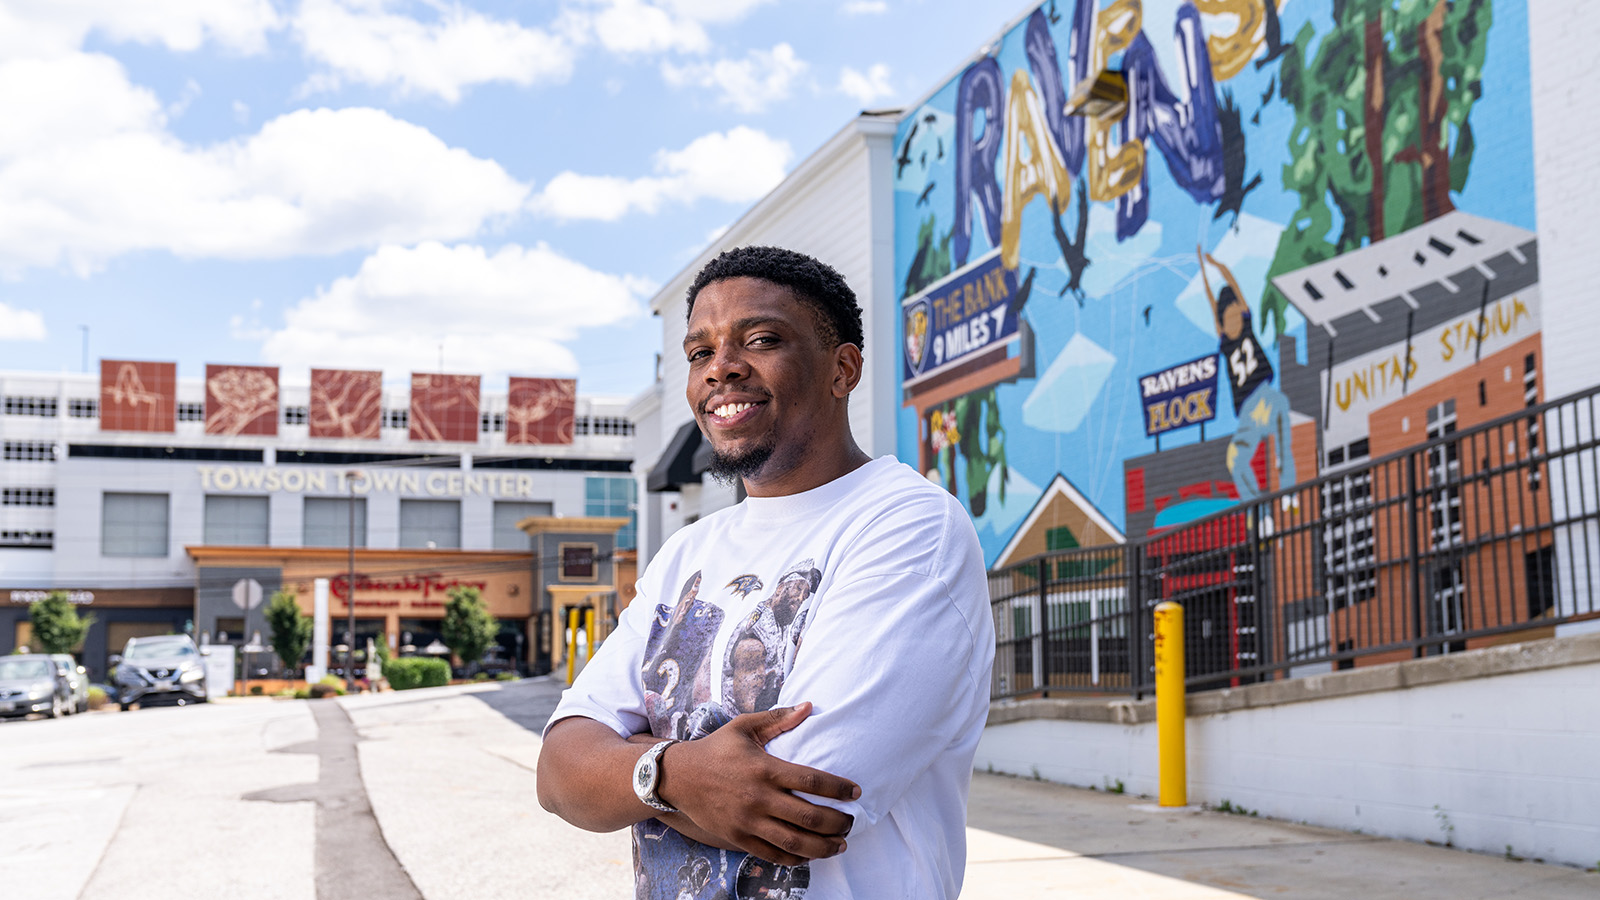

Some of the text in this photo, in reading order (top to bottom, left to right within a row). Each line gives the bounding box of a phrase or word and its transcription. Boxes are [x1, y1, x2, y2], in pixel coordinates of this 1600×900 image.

[933, 267, 1009, 330] THE BANK
[933, 335, 944, 365] 9
[945, 312, 990, 360] MILES
[1335, 297, 1531, 411] UNITAS STADIUM
[1141, 357, 1216, 397] RAVENS
[1147, 388, 1213, 434] FLOCK
[198, 466, 534, 498] TOWSON TOWN CENTER
